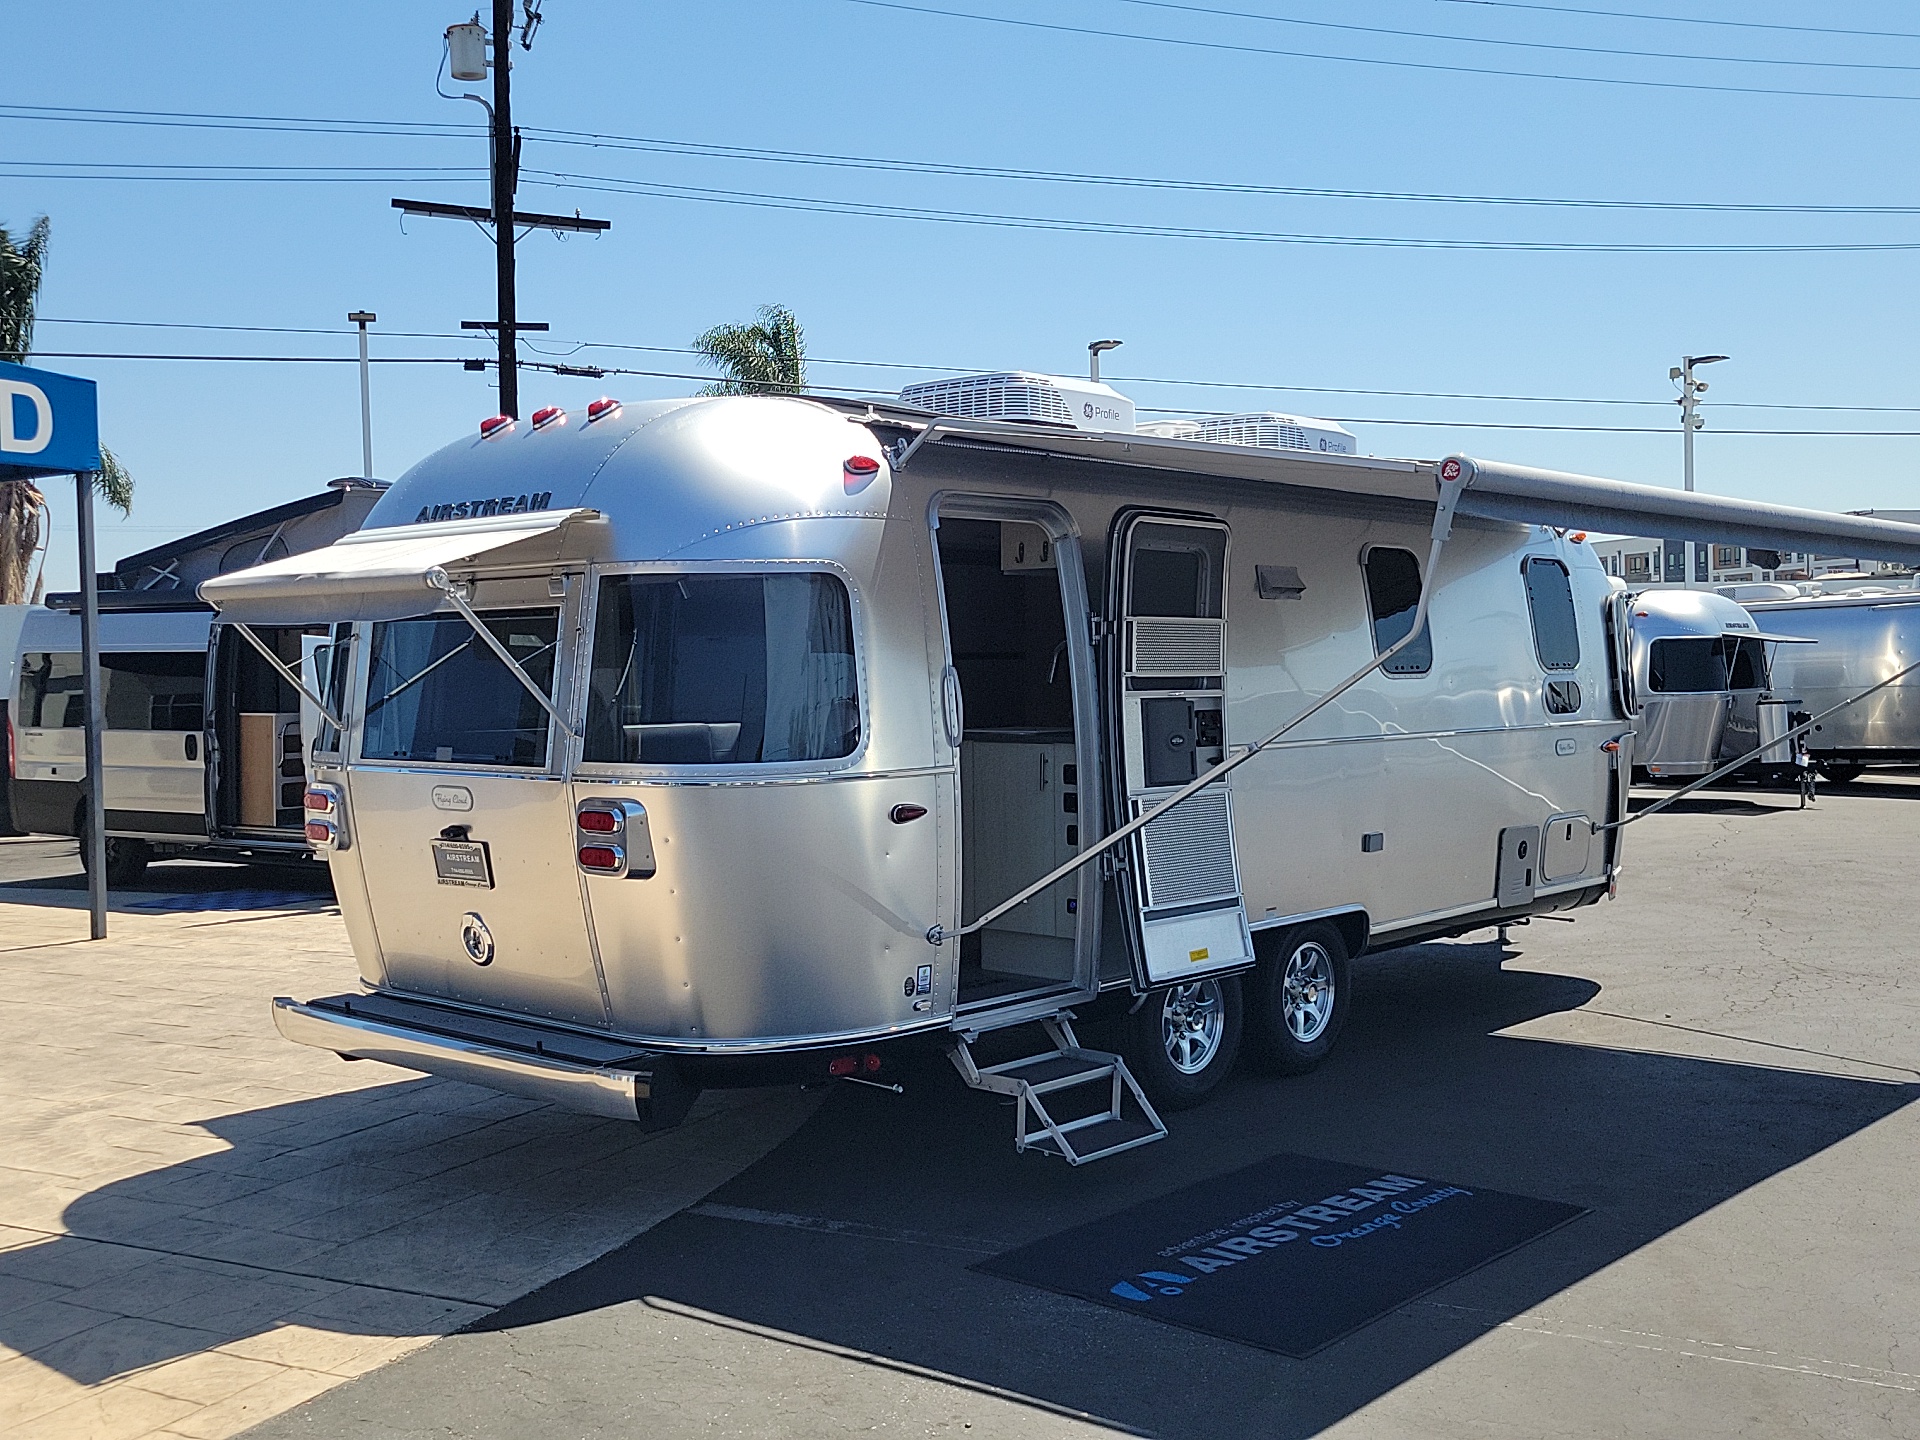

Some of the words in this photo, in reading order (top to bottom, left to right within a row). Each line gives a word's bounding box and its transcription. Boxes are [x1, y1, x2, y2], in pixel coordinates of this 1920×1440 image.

[0, 379, 53, 454] D
[1095, 407, 1120, 420] Profile
[415, 491, 552, 523] AIRSTREAM
[446, 853, 480, 863] AIRSTREAM
[437, 879, 465, 887] AIRSTREAM
[1178, 1174, 1427, 1274] AIRSTREAM
[1310, 1213, 1402, 1247] Orange
[1390, 1186, 1474, 1214] County
